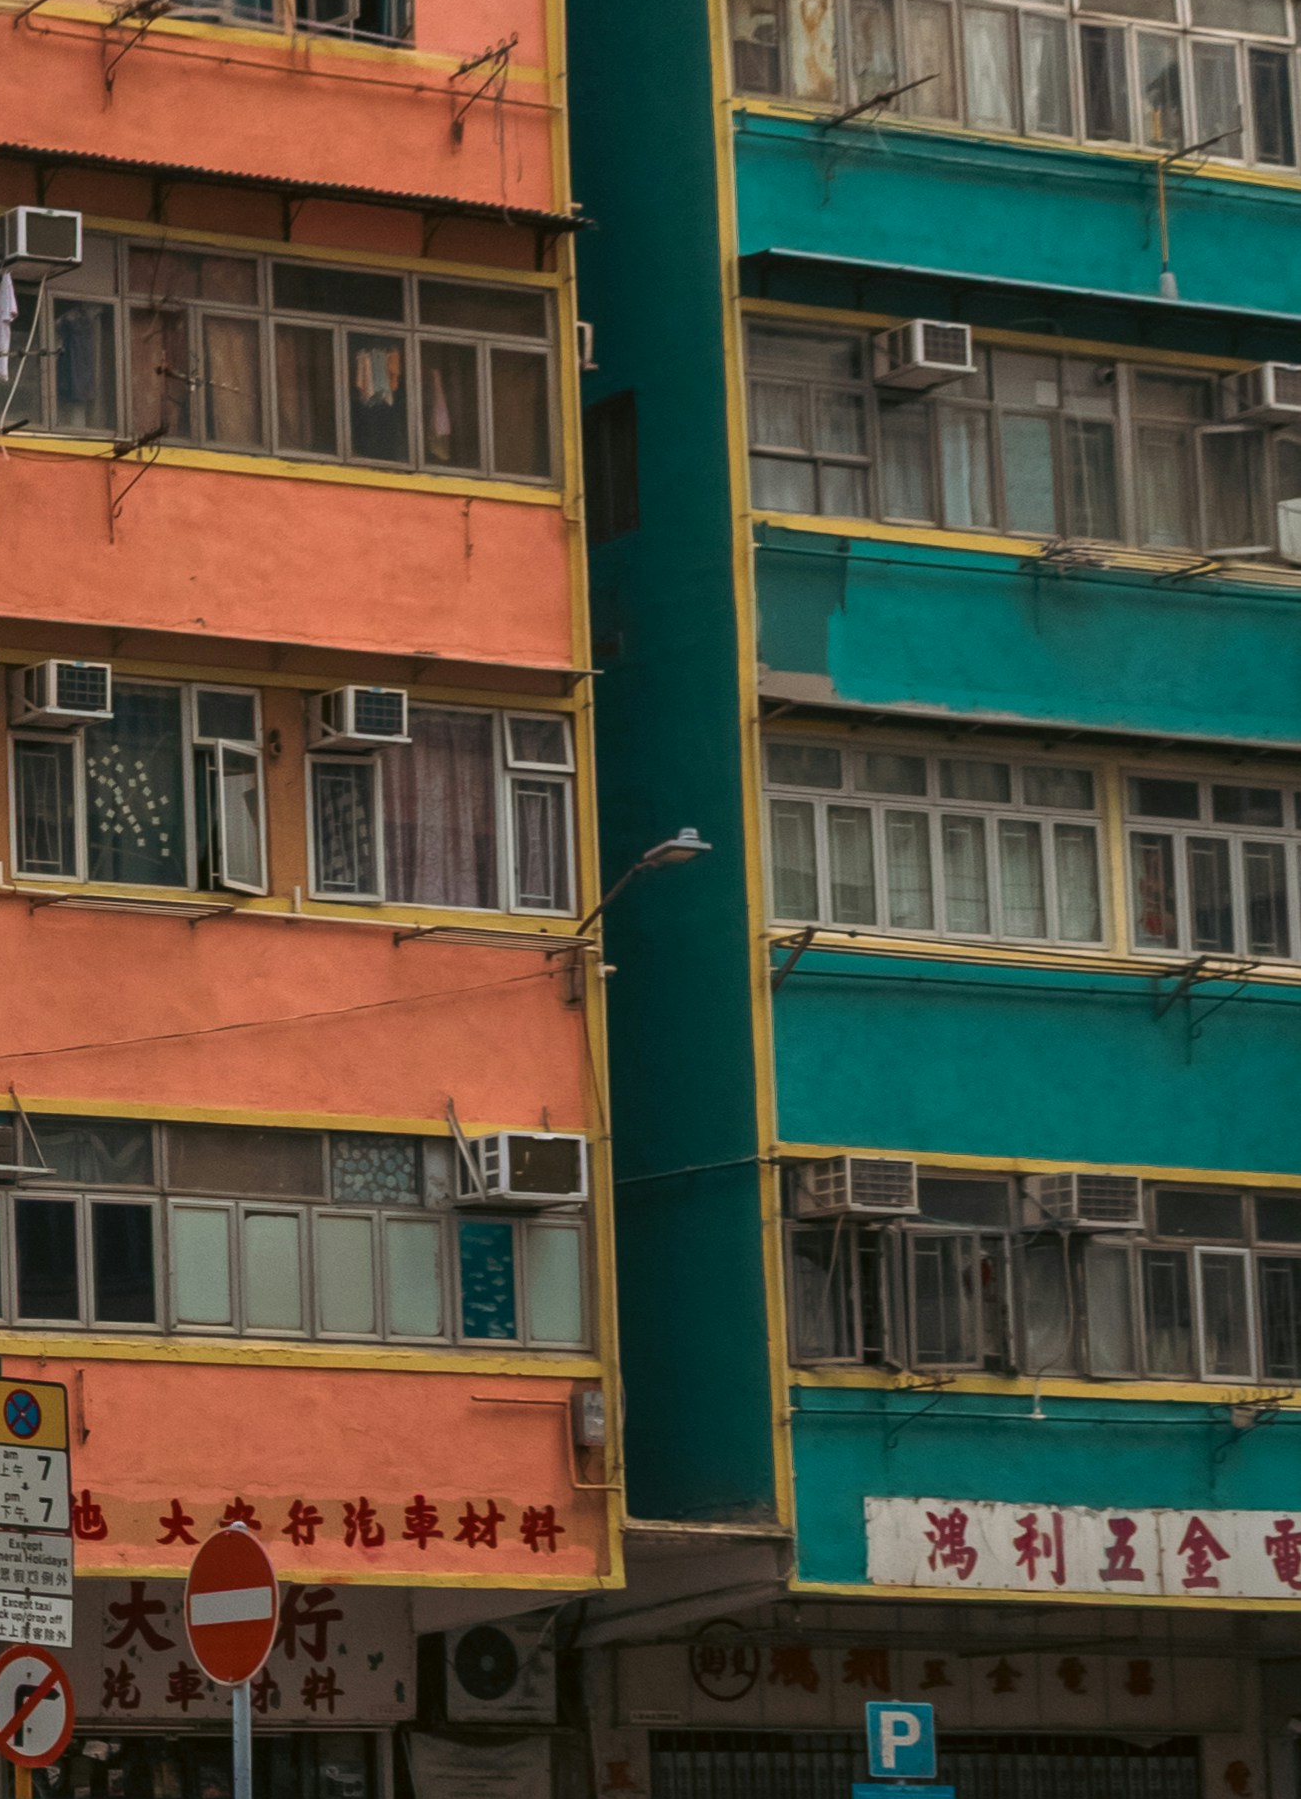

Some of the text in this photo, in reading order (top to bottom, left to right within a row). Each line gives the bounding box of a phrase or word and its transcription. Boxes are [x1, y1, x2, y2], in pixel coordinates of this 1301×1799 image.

[0, 1462, 24, 1478] 上午
[3, 1450, 52, 1481] am 7
[0, 1504, 25, 1520] 下午
[4, 1492, 53, 1522] pm 7
[9, 1538, 43, 1552] Except
[25, 1553, 68, 1568] Holidays
[2, 1595, 52, 1611] Except taxi
[11, 1612, 47, 1624] up/drop
[49, 1614, 63, 1624] off
[880, 1711, 921, 1769] P
